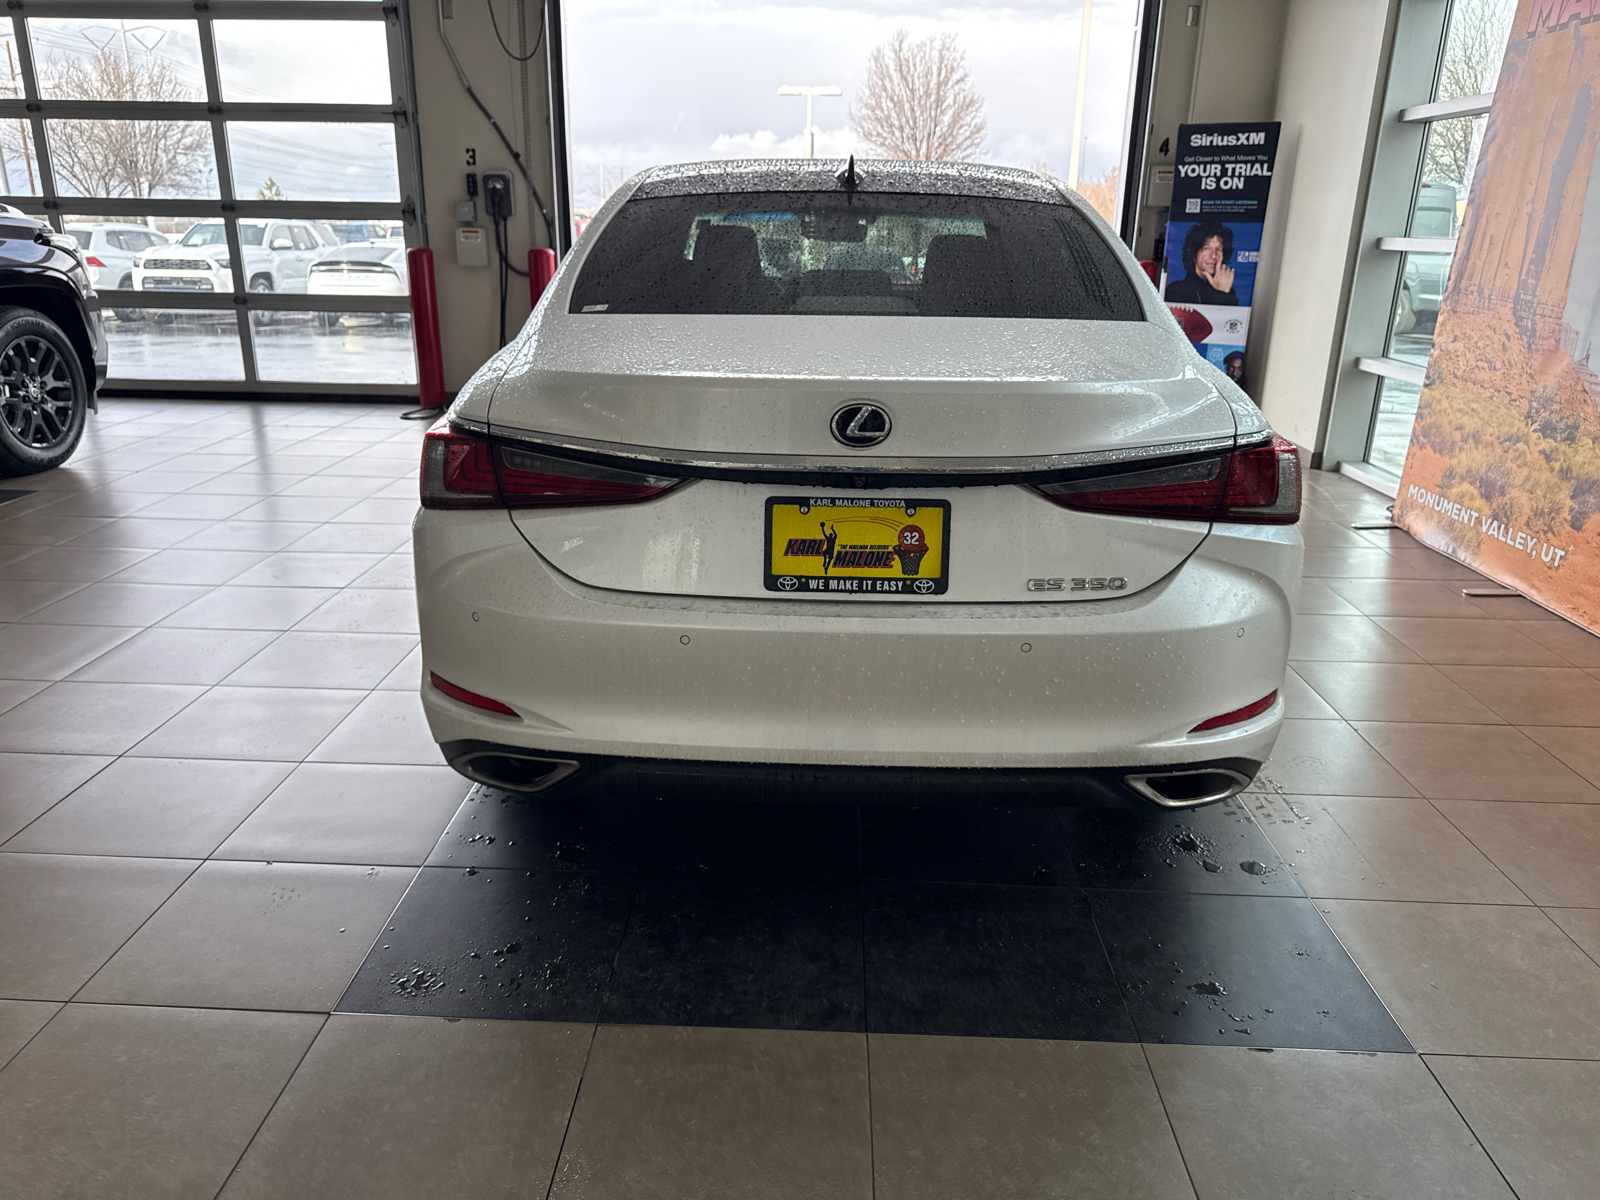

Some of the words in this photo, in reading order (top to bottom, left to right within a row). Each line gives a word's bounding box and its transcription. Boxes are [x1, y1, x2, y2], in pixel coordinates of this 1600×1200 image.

[1158, 137, 1170, 157] 4
[1190, 132, 1266, 147] SiriusXM
[465, 147, 476, 166] 3
[1195, 155, 1213, 163] Closer
[1236, 154, 1256, 162] Moves
[1177, 163, 1222, 177] YOUR
[1224, 163, 1272, 176] TRIAL
[1200, 177, 1217, 190] IS
[1219, 176, 1245, 190] ON
[809, 498, 833, 507] KARL
[835, 499, 871, 508] MALONE
[873, 500, 906, 508] TOYOTA
[1407, 483, 1479, 527] MONUMENT
[1481, 515, 1537, 560] VALLEY,
[1541, 542, 1566, 567] UT
[903, 531, 920, 545] 32
[784, 539, 826, 557] KARL
[833, 551, 895, 568] MALONE
[809, 579, 825, 590] WE
[828, 579, 859, 591] MAKE
[862, 580, 872, 591] IT
[876, 580, 903, 591] EASY
[1027, 578, 1066, 592] ES
[1070, 577, 1128, 591] 350
